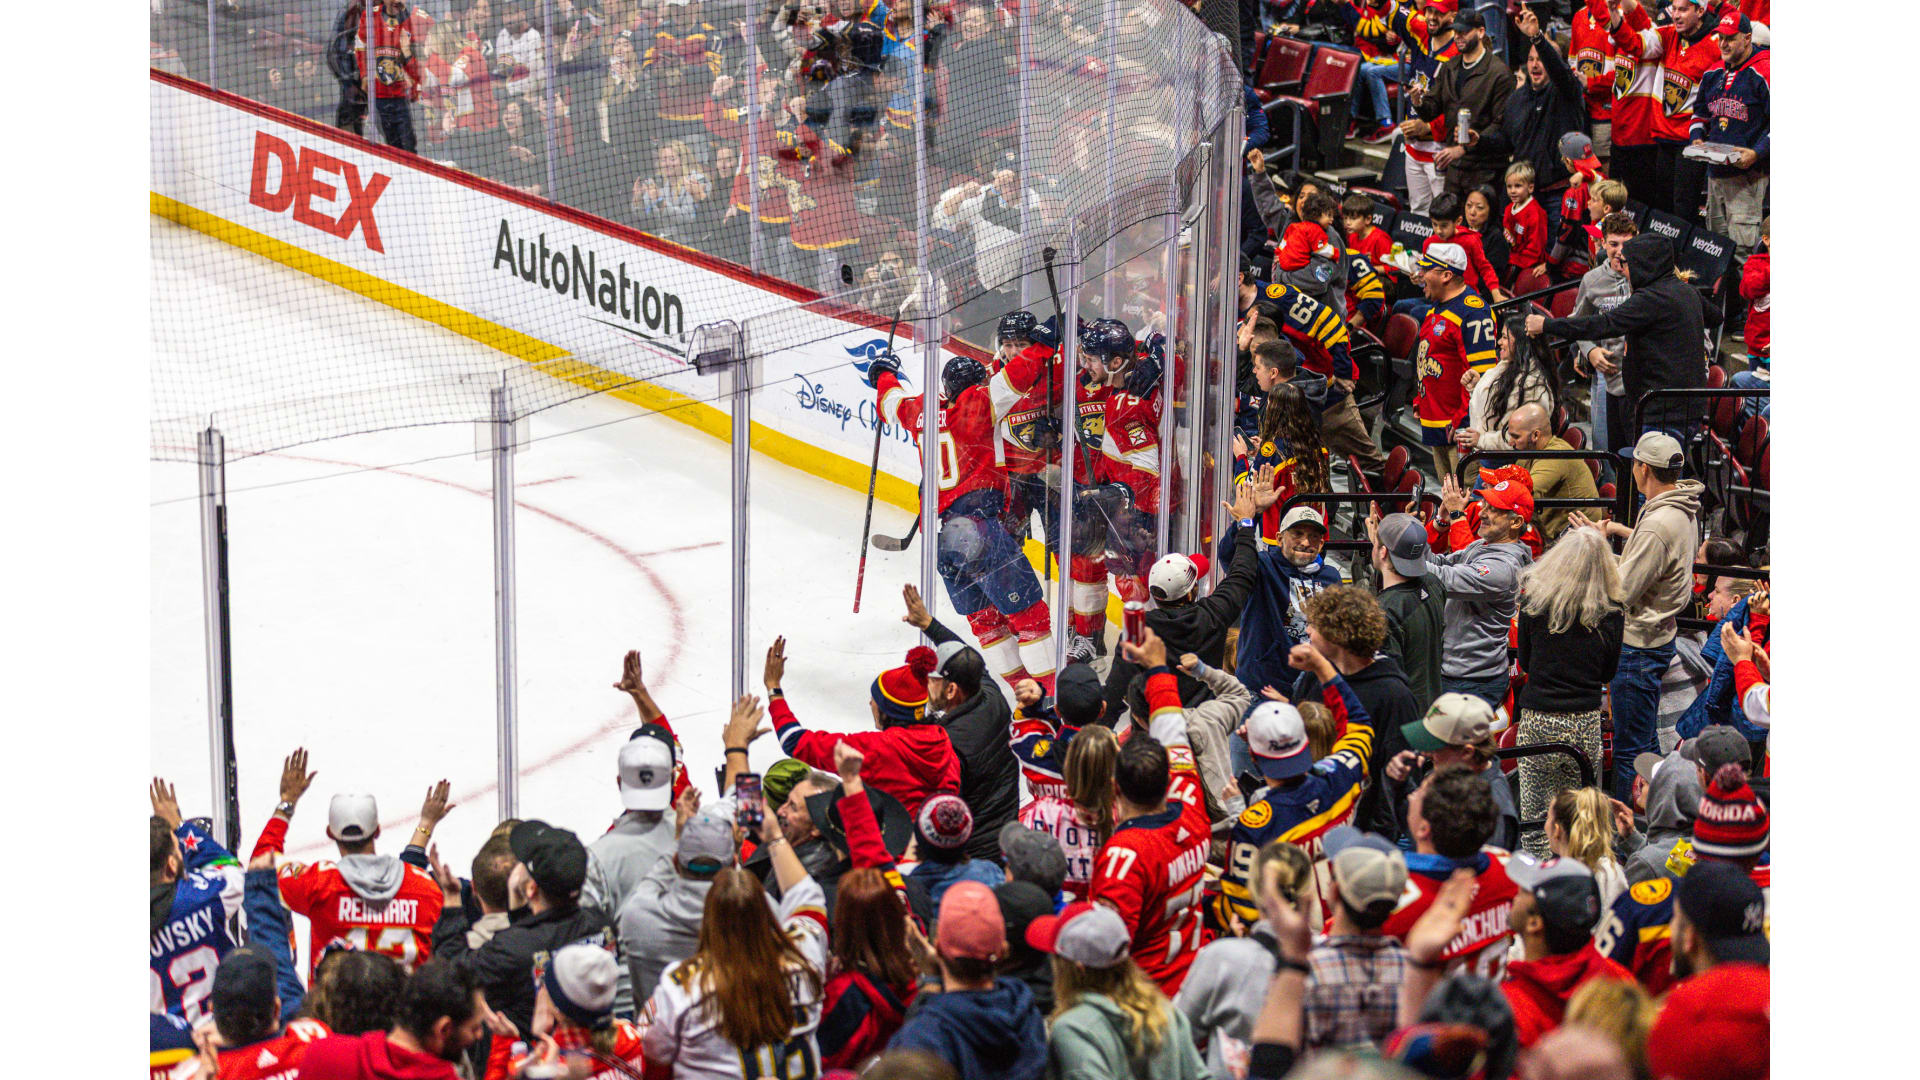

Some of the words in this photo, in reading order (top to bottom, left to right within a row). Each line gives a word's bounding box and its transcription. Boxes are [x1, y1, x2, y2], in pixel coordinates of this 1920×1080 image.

[249, 130, 392, 254] DEX
[1400, 219, 1434, 237] verizon
[1650, 218, 1681, 239] verizon
[1692, 237, 1723, 258] verizon
[493, 218, 685, 341] AutoNation
[1289, 292, 1319, 325] 63
[1466, 318, 1495, 345] 72
[1105, 846, 1137, 880] 77
